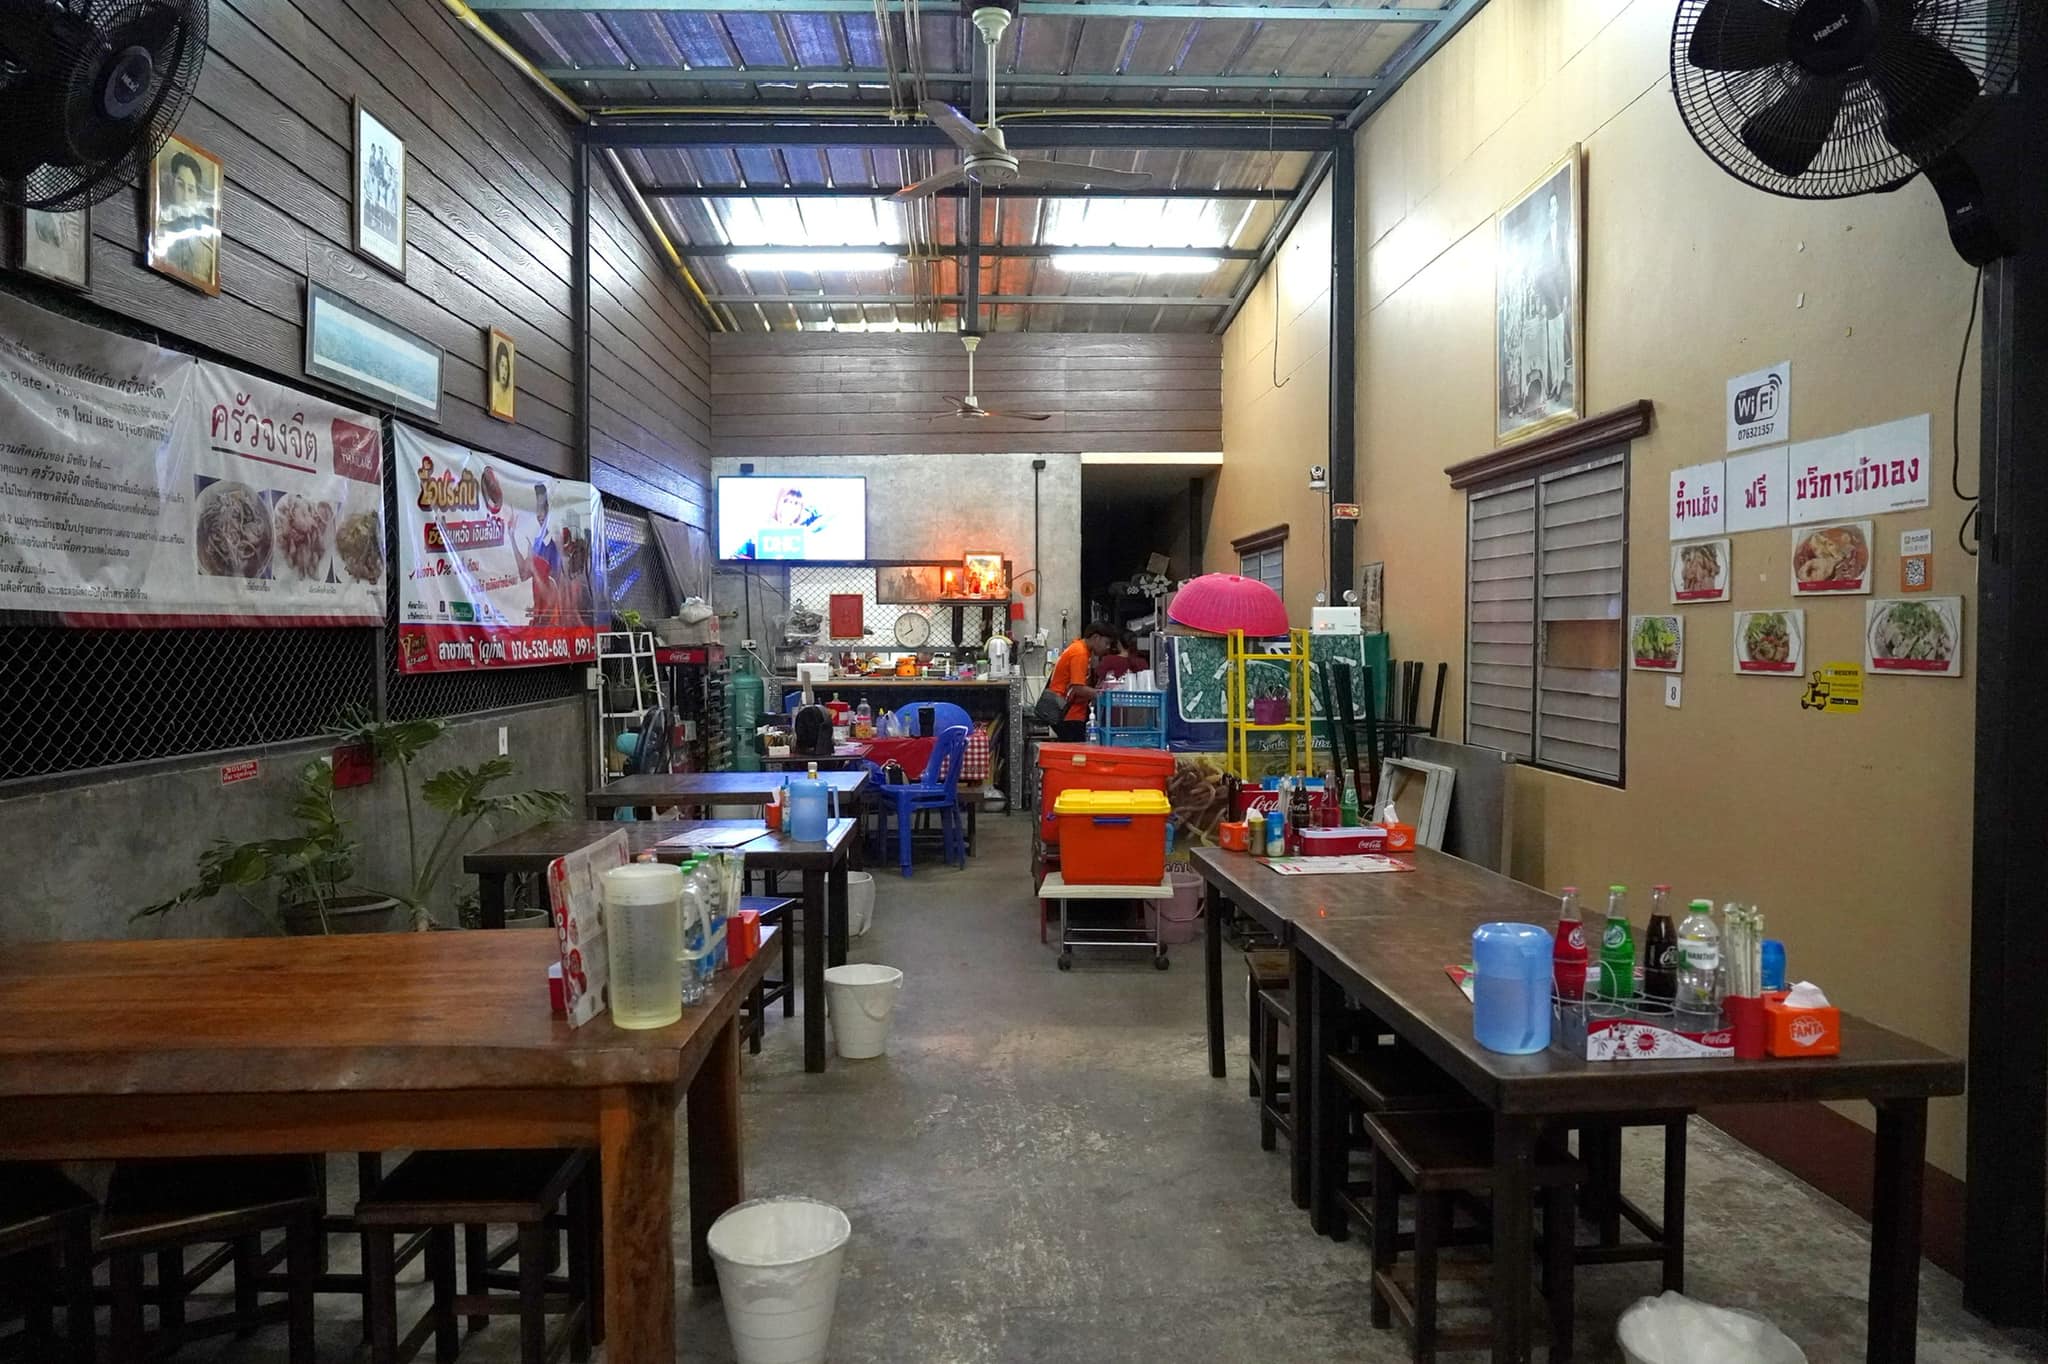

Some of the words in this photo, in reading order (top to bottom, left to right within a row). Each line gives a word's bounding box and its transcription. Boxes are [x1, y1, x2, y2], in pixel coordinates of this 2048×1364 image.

[211, 392, 318, 464] ครัวจงจิต
[1737, 423, 1775, 440] 076321357
[1744, 474, 1769, 510] ฟรี
[1796, 456, 1920, 500] บริการตัวเอง
[1676, 481, 1719, 523] น้ำแข็ง
[1670, 686, 1677, 701] 8
